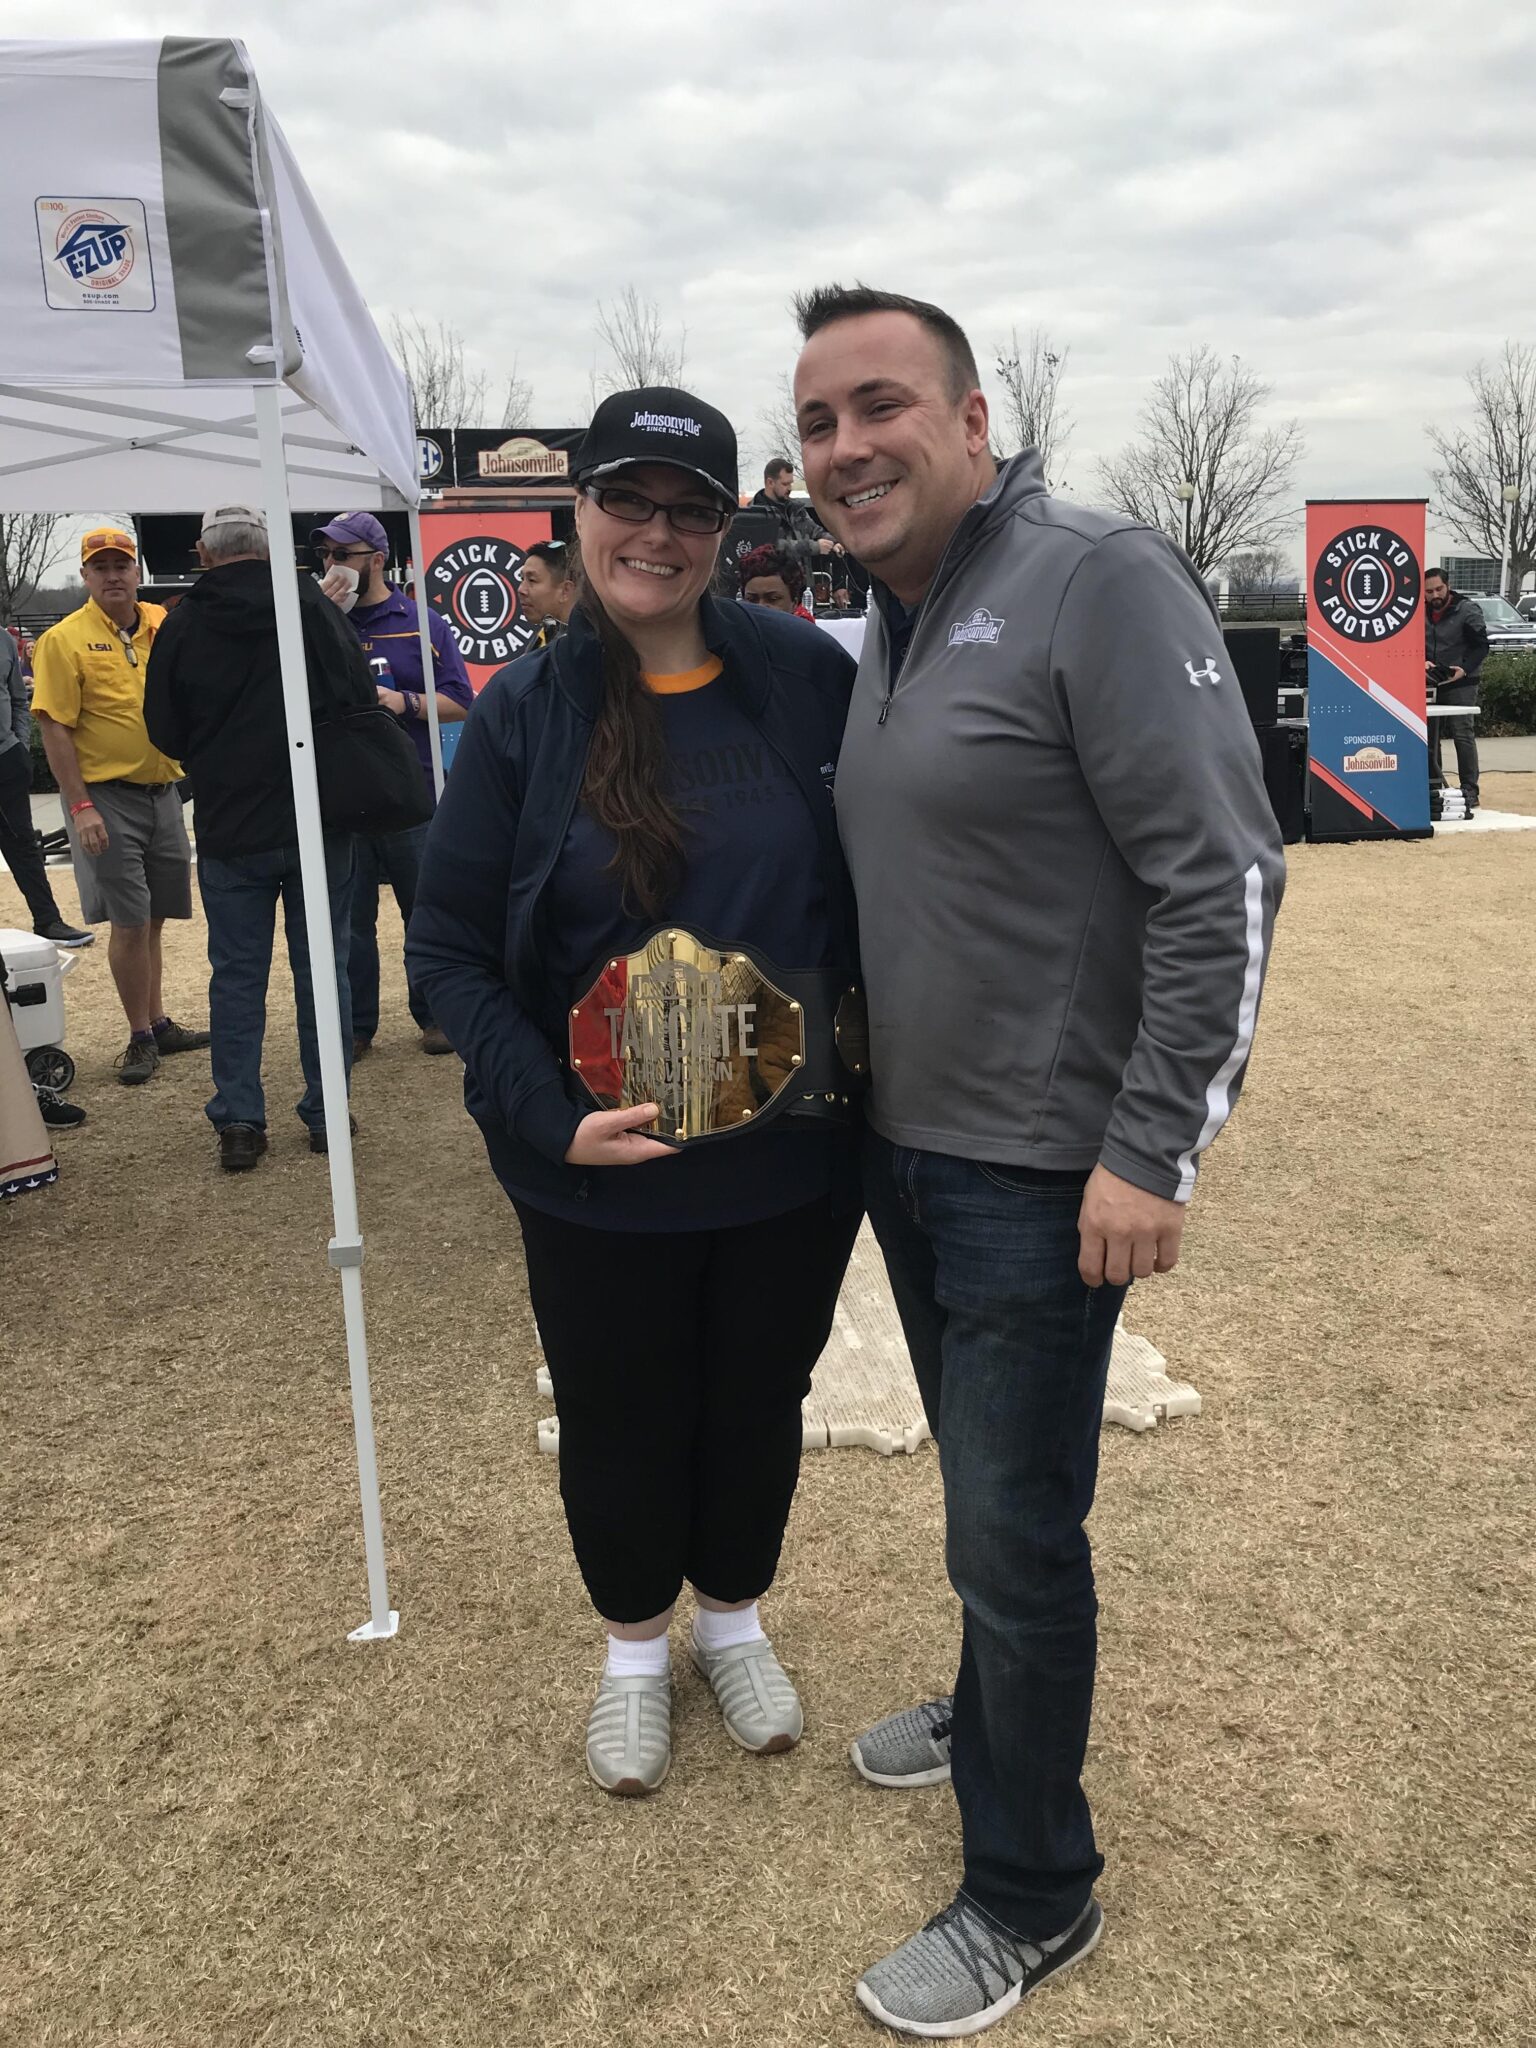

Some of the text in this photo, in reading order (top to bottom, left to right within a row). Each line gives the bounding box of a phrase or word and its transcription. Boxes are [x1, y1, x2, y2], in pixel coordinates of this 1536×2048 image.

[90, 276, 119, 287] ORIGINAL
[630, 410, 700, 437] Johnsonville
[646, 426, 684, 437] SINCE 1945
[483, 453, 565, 475] Johnsonville
[1326, 532, 1409, 568] STICK TO
[434, 544, 498, 583] STICK
[1322, 595, 1415, 638] FOOTBALL
[87, 643, 113, 652] LSU
[1343, 734, 1396, 745] SPONSORED BY
[1345, 756, 1395, 771] Johnsonville
[604, 1003, 758, 1060] TAILGATE
